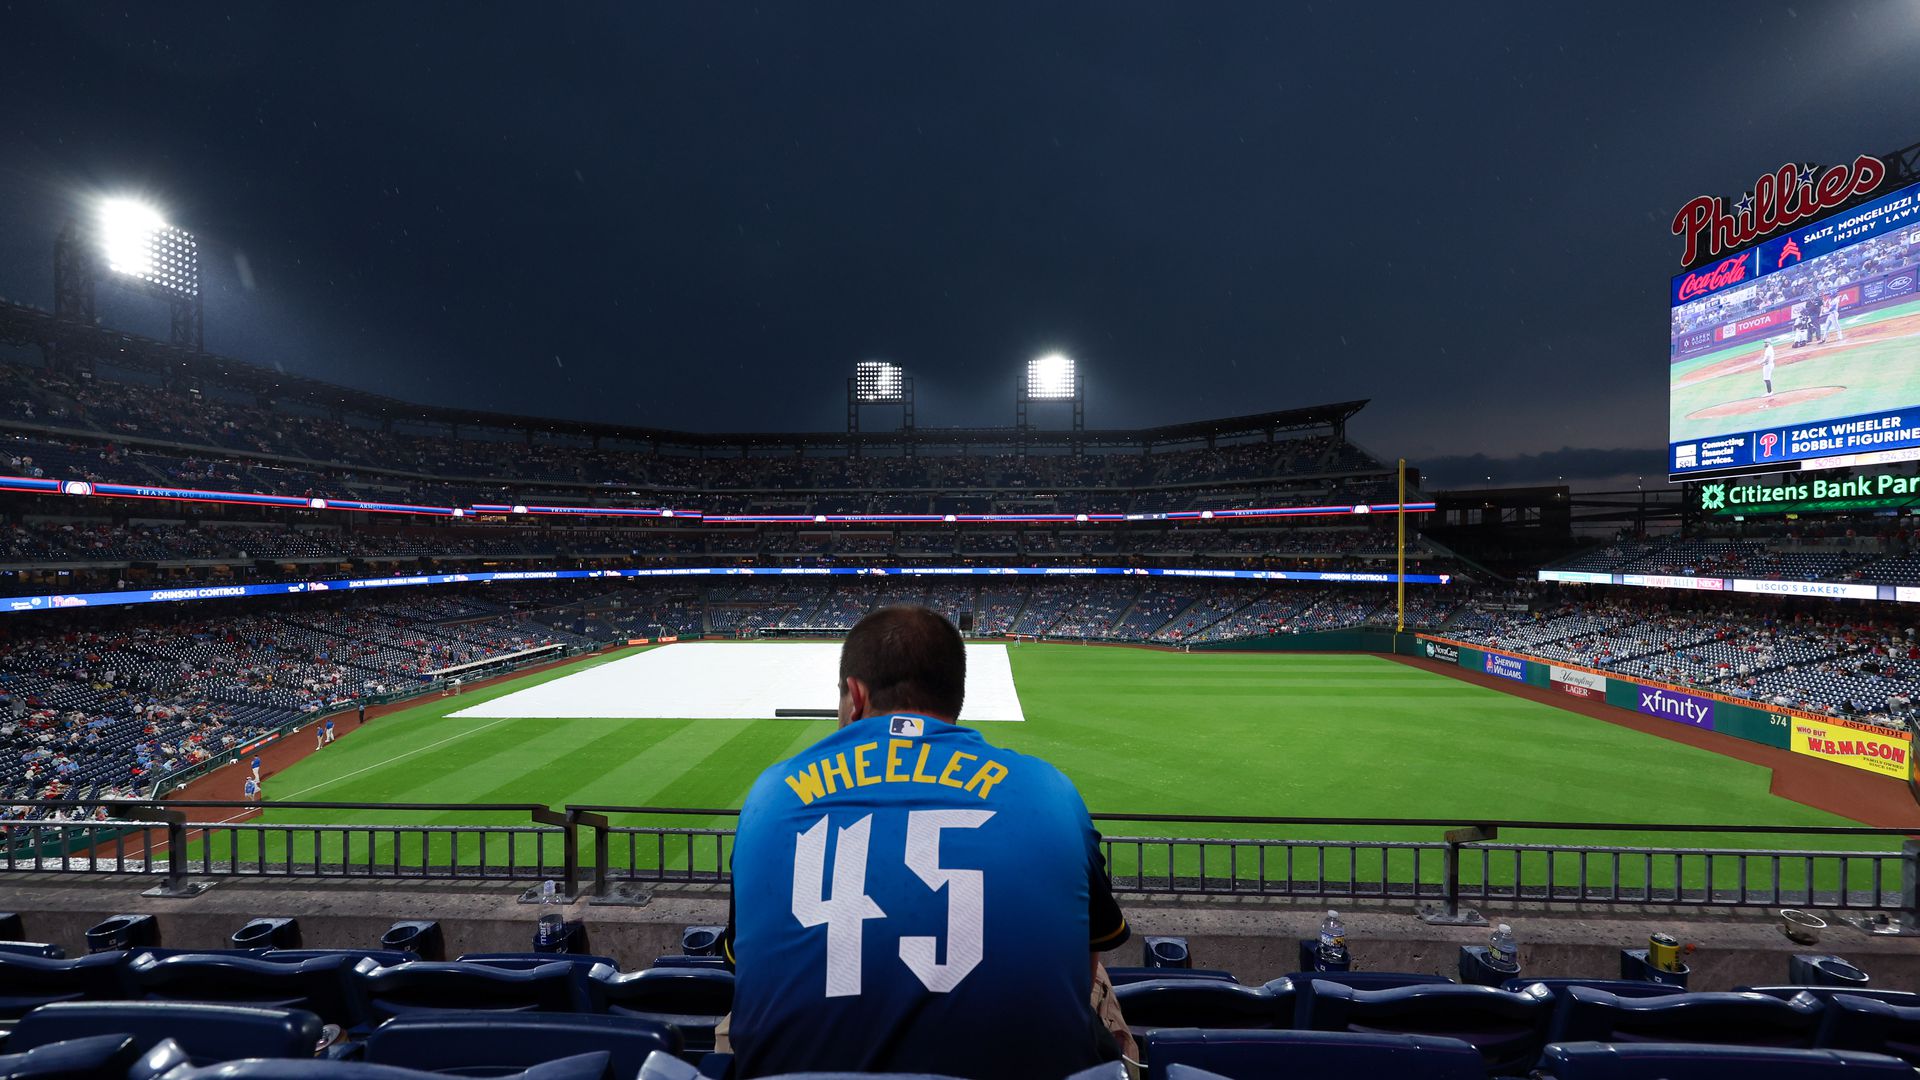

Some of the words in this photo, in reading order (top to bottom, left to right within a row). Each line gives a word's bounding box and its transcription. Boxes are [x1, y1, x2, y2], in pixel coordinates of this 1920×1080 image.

[1672, 155, 1885, 267] Phillies
[1804, 226, 1834, 243] SALTZ
[1838, 196, 1911, 230] MONGELUZZI
[1834, 221, 1876, 242] INJURY
[1678, 253, 1749, 300] Coca-Cola
[1738, 316, 1771, 331] TOYOTA
[1792, 427, 1827, 441] ZACK
[1832, 416, 1901, 435] WHEELER
[1702, 438, 1744, 449] Connecting
[1791, 439, 1843, 453] BOBBLE
[1848, 427, 1920, 448] FIGURINE
[1702, 446, 1734, 457] financial
[136, 488, 171, 497] THANK
[1729, 484, 1808, 504] Citizens
[1813, 478, 1872, 500] Bank
[1646, 577, 1671, 586] POWER
[1674, 578, 1694, 587] ALLEY
[1756, 583, 1798, 592] LISCIO'S
[1802, 585, 1847, 595] BAKERY
[150, 589, 198, 600] JOHNSON
[199, 586, 245, 597] CONTROLS
[1434, 644, 1458, 657] NovaCare
[1494, 655, 1522, 670] SHERWIN
[1560, 669, 1594, 688] Yuengling
[1565, 685, 1588, 697] LAGER
[1596, 669, 1627, 680] ASPLUNDH
[1633, 677, 1668, 689] ASPLUNDH
[1674, 686, 1714, 699] ASPLUNDH
[1722, 695, 1767, 710] ASPLUNDH
[1776, 706, 1828, 723] ASPLUNDH
[1842, 721, 1903, 739] ASPLUNDH
[1641, 690, 1708, 723] xfinity
[1770, 714, 1787, 728] 374
[1796, 726, 1811, 734] WHO
[1813, 729, 1827, 737] BUT
[1808, 737, 1905, 764] W.B.MASON
[784, 739, 1009, 806] WHEELER
[792, 809, 997, 998] 45
[539, 920, 547, 945] mart
